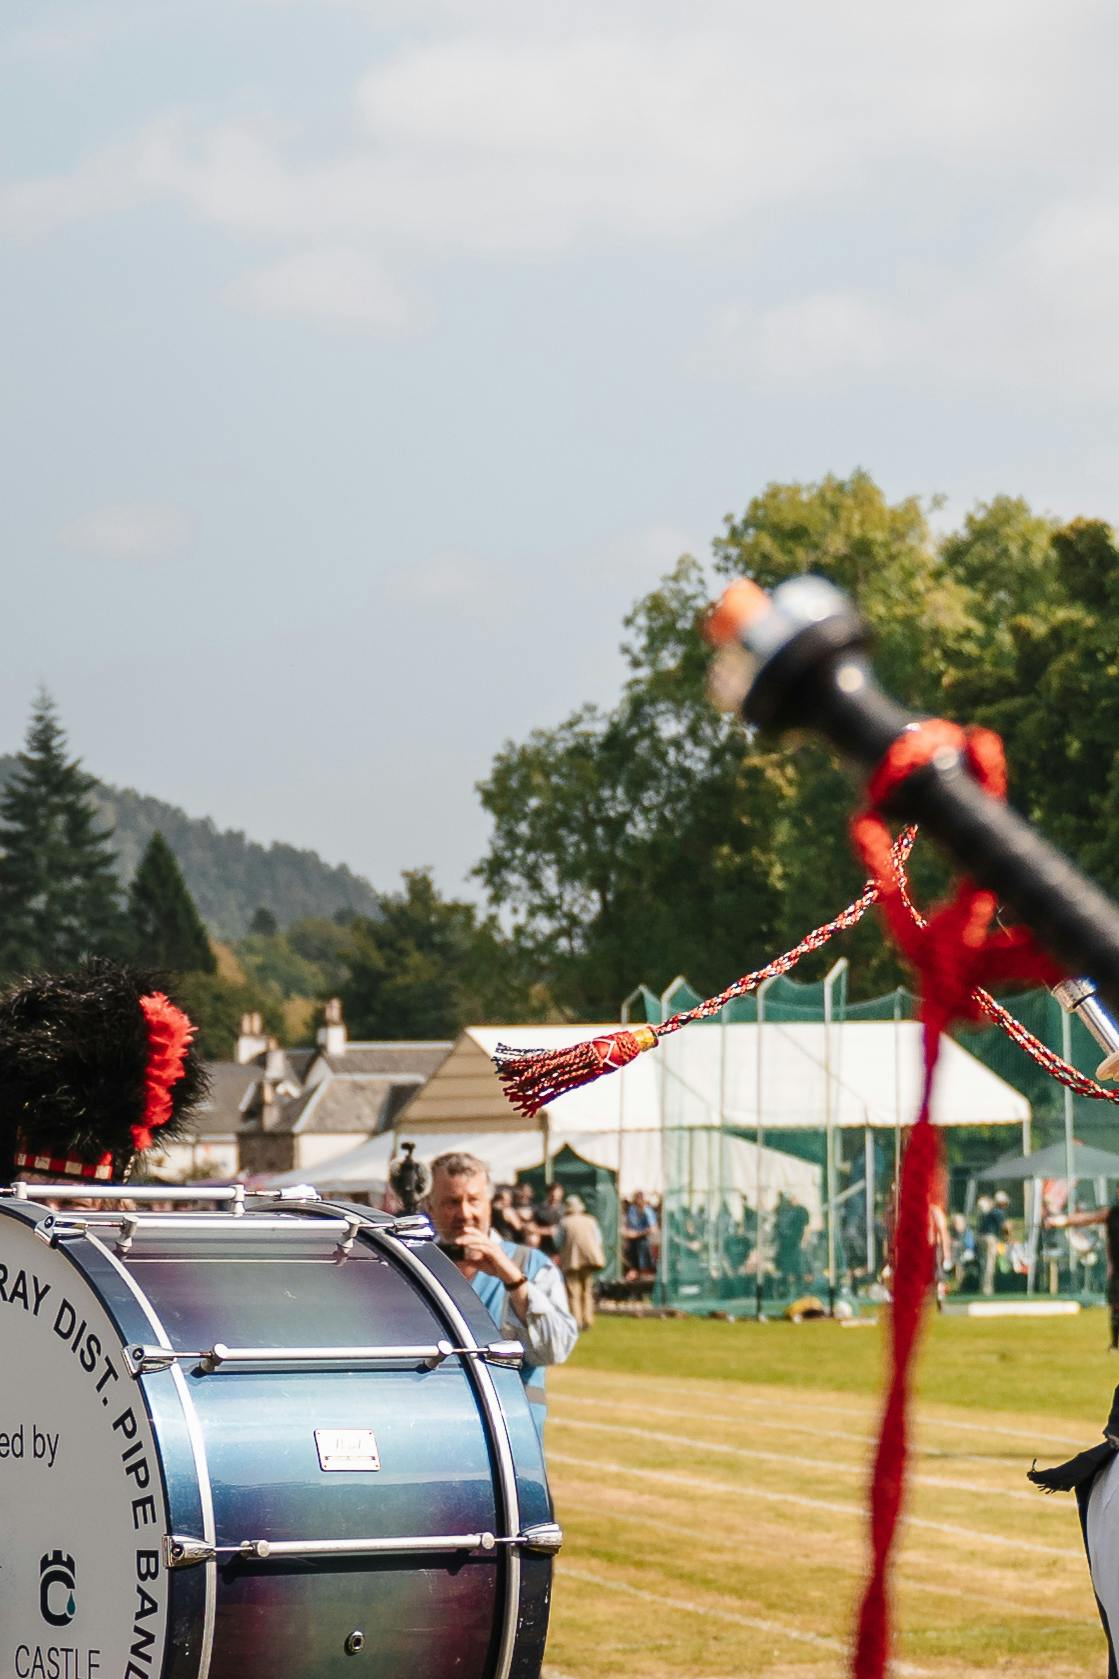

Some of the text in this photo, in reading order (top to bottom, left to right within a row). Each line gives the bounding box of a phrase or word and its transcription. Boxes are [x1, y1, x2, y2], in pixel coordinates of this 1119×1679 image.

[33, 1424, 59, 1468] by
[53, 1298, 118, 1406] DIST.
[112, 1407, 157, 1530] PIPE
